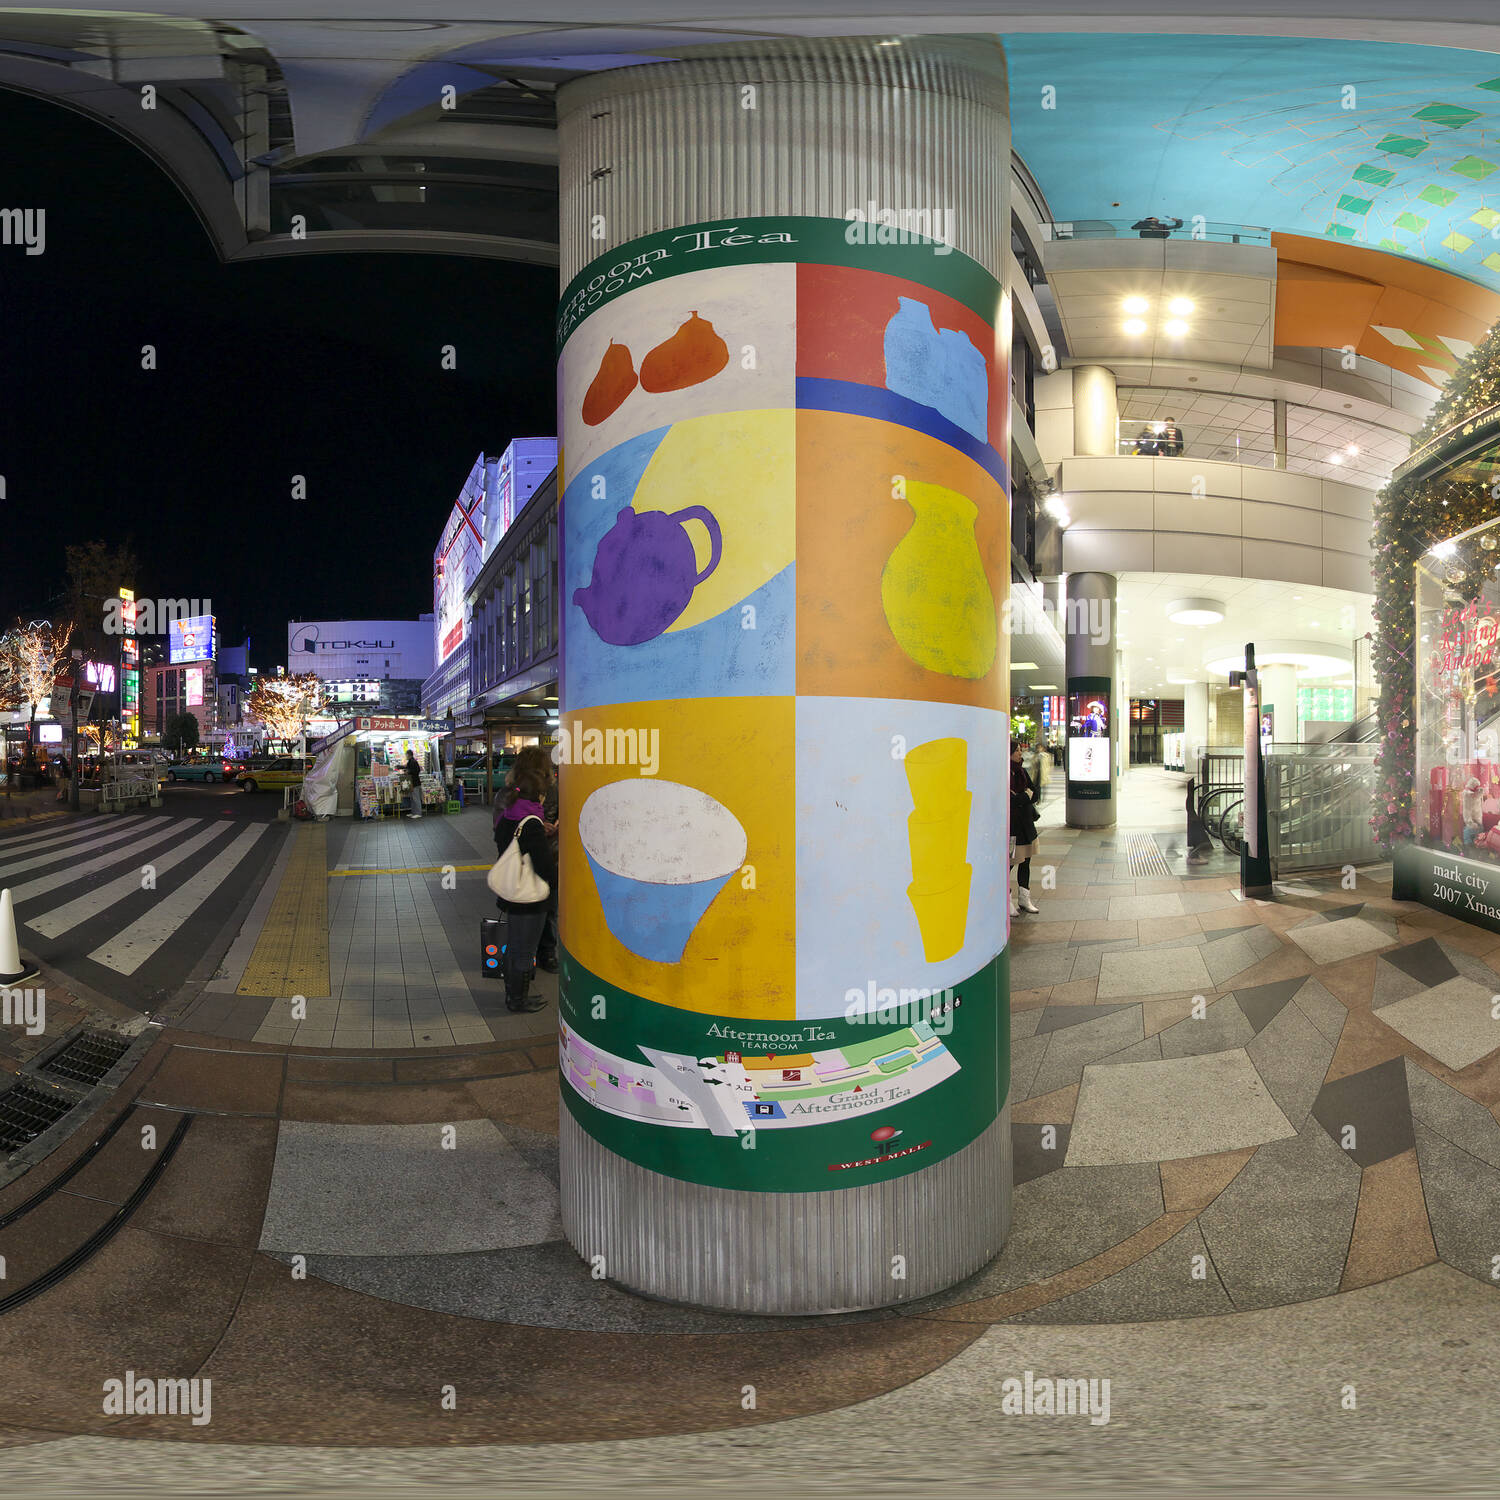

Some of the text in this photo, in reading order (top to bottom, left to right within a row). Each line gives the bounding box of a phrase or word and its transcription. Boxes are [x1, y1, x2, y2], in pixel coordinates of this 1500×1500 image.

[672, 227, 799, 253] Tea
[315, 640, 395, 649] TOKYU
[373, 720, 406, 729] アットホーム
[421, 721, 449, 731] アットホーム
[1433, 864, 1489, 895] mark city
[1433, 882, 1461, 906] 2007
[706, 1023, 836, 1042] Afternoon Tea
[741, 1042, 799, 1050] TEAROOM
[735, 1084, 752, 1092] 入口
[828, 1088, 879, 1105] Grand
[790, 1087, 912, 1115] Afternoon Tea
[840, 1143, 926, 1170] WEST MALL
